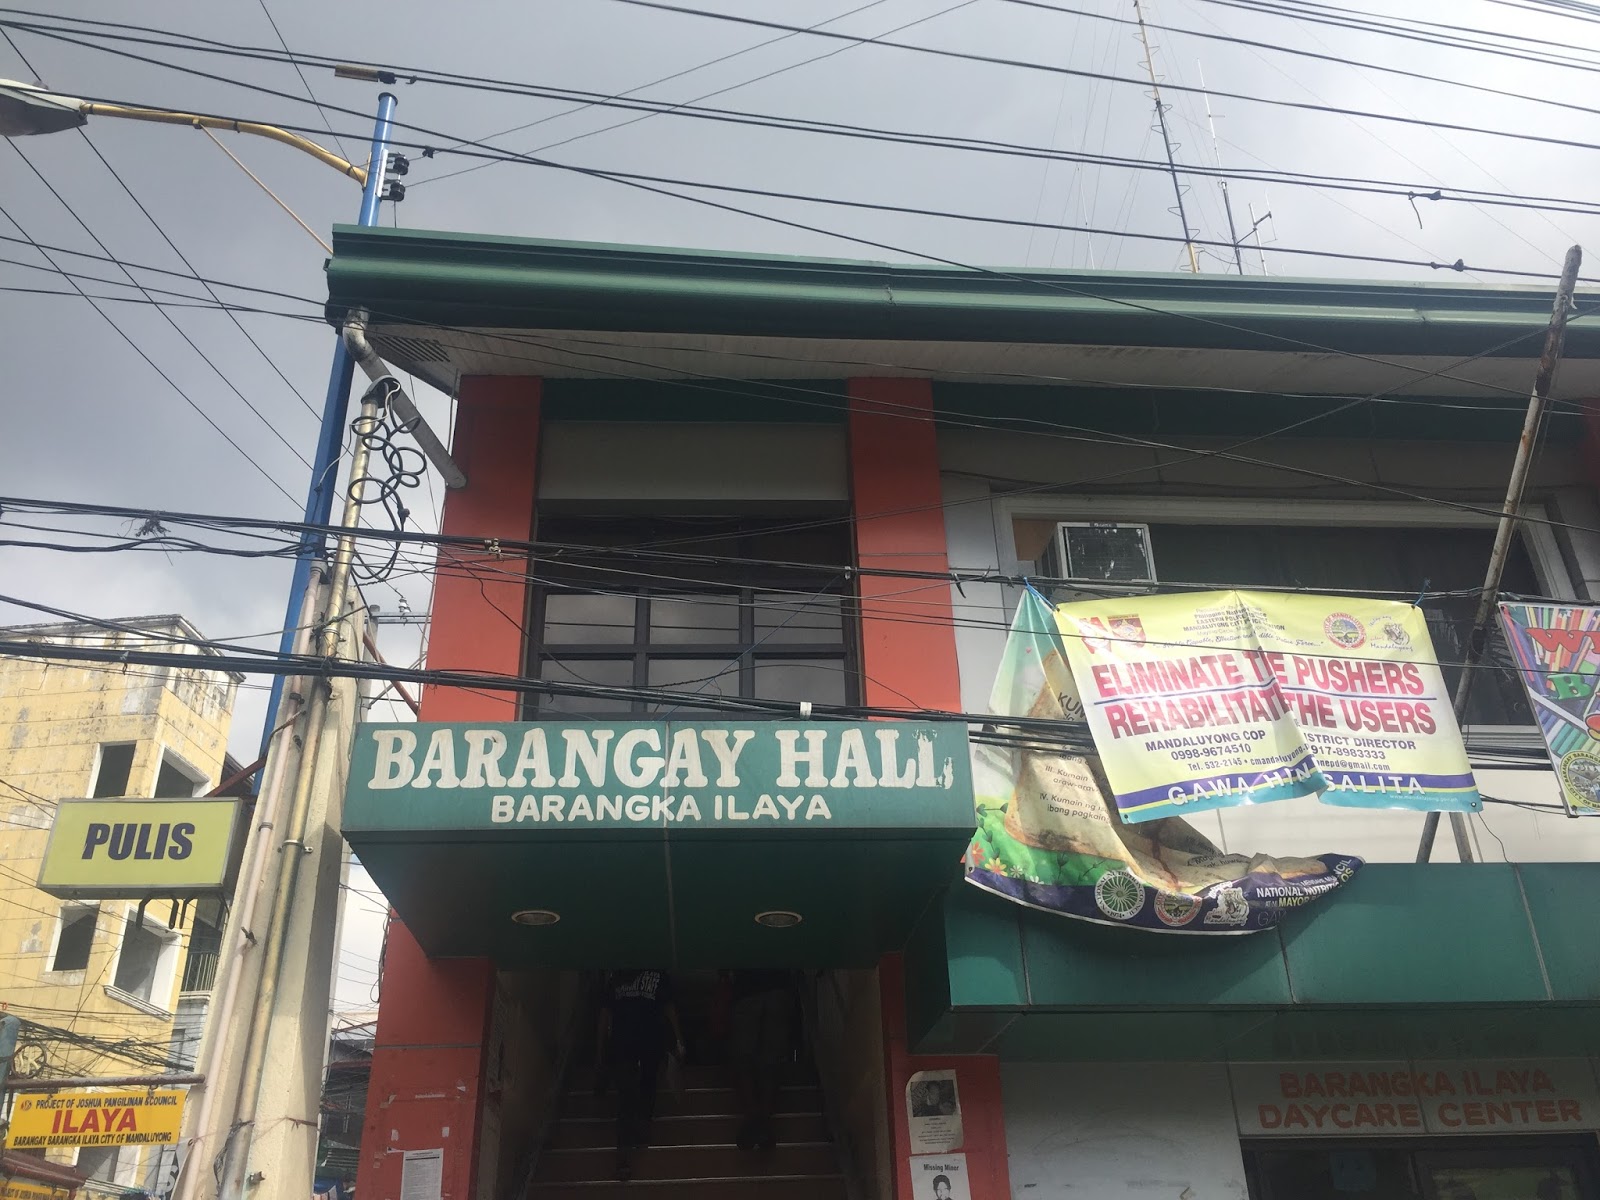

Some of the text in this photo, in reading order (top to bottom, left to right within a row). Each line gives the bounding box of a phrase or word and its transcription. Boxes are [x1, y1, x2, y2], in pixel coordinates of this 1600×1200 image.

[1091, 654, 1246, 698] ELIMINATE
[1292, 655, 1425, 696] PUSHERS
[1340, 699, 1437, 735] USERS
[1145, 729, 1266, 752] MANDALUYONG COP
[1304, 732, 1417, 750] ISTRICT DIRECTOR
[367, 727, 954, 790] BARANGAY HALL
[1171, 743, 1251, 761] 0998-9674510
[1311, 744, 1386, 760] 917-8983333
[1204, 757, 1243, 769] 532-2145
[1167, 776, 1256, 806] GAWA
[1323, 773, 1426, 795] SALITA
[491, 794, 833, 823] BARANGKA ILAYA
[1047, 803, 1070, 816] ibang
[1051, 794, 1083, 807] Kumain
[81, 822, 196, 861] PULIS
[1256, 886, 1305, 898] NATIONAL
[1279, 1067, 1556, 1099] BARANGKA ILAYA
[35, 1099, 65, 1109] PROJECT
[66, 1099, 75, 1109] OF
[76, 1098, 102, 1108] JOSHUA
[104, 1096, 143, 1107] PANGILINAN
[52, 1108, 137, 1134] ILAYA
[1257, 1099, 1584, 1129] DAYCARE CENTER
[13, 1132, 172, 1146] BARANGAY BARANGKA ILAYA CITY OF MANDALUYONG
[923, 1163, 960, 1173] Missing Minor
